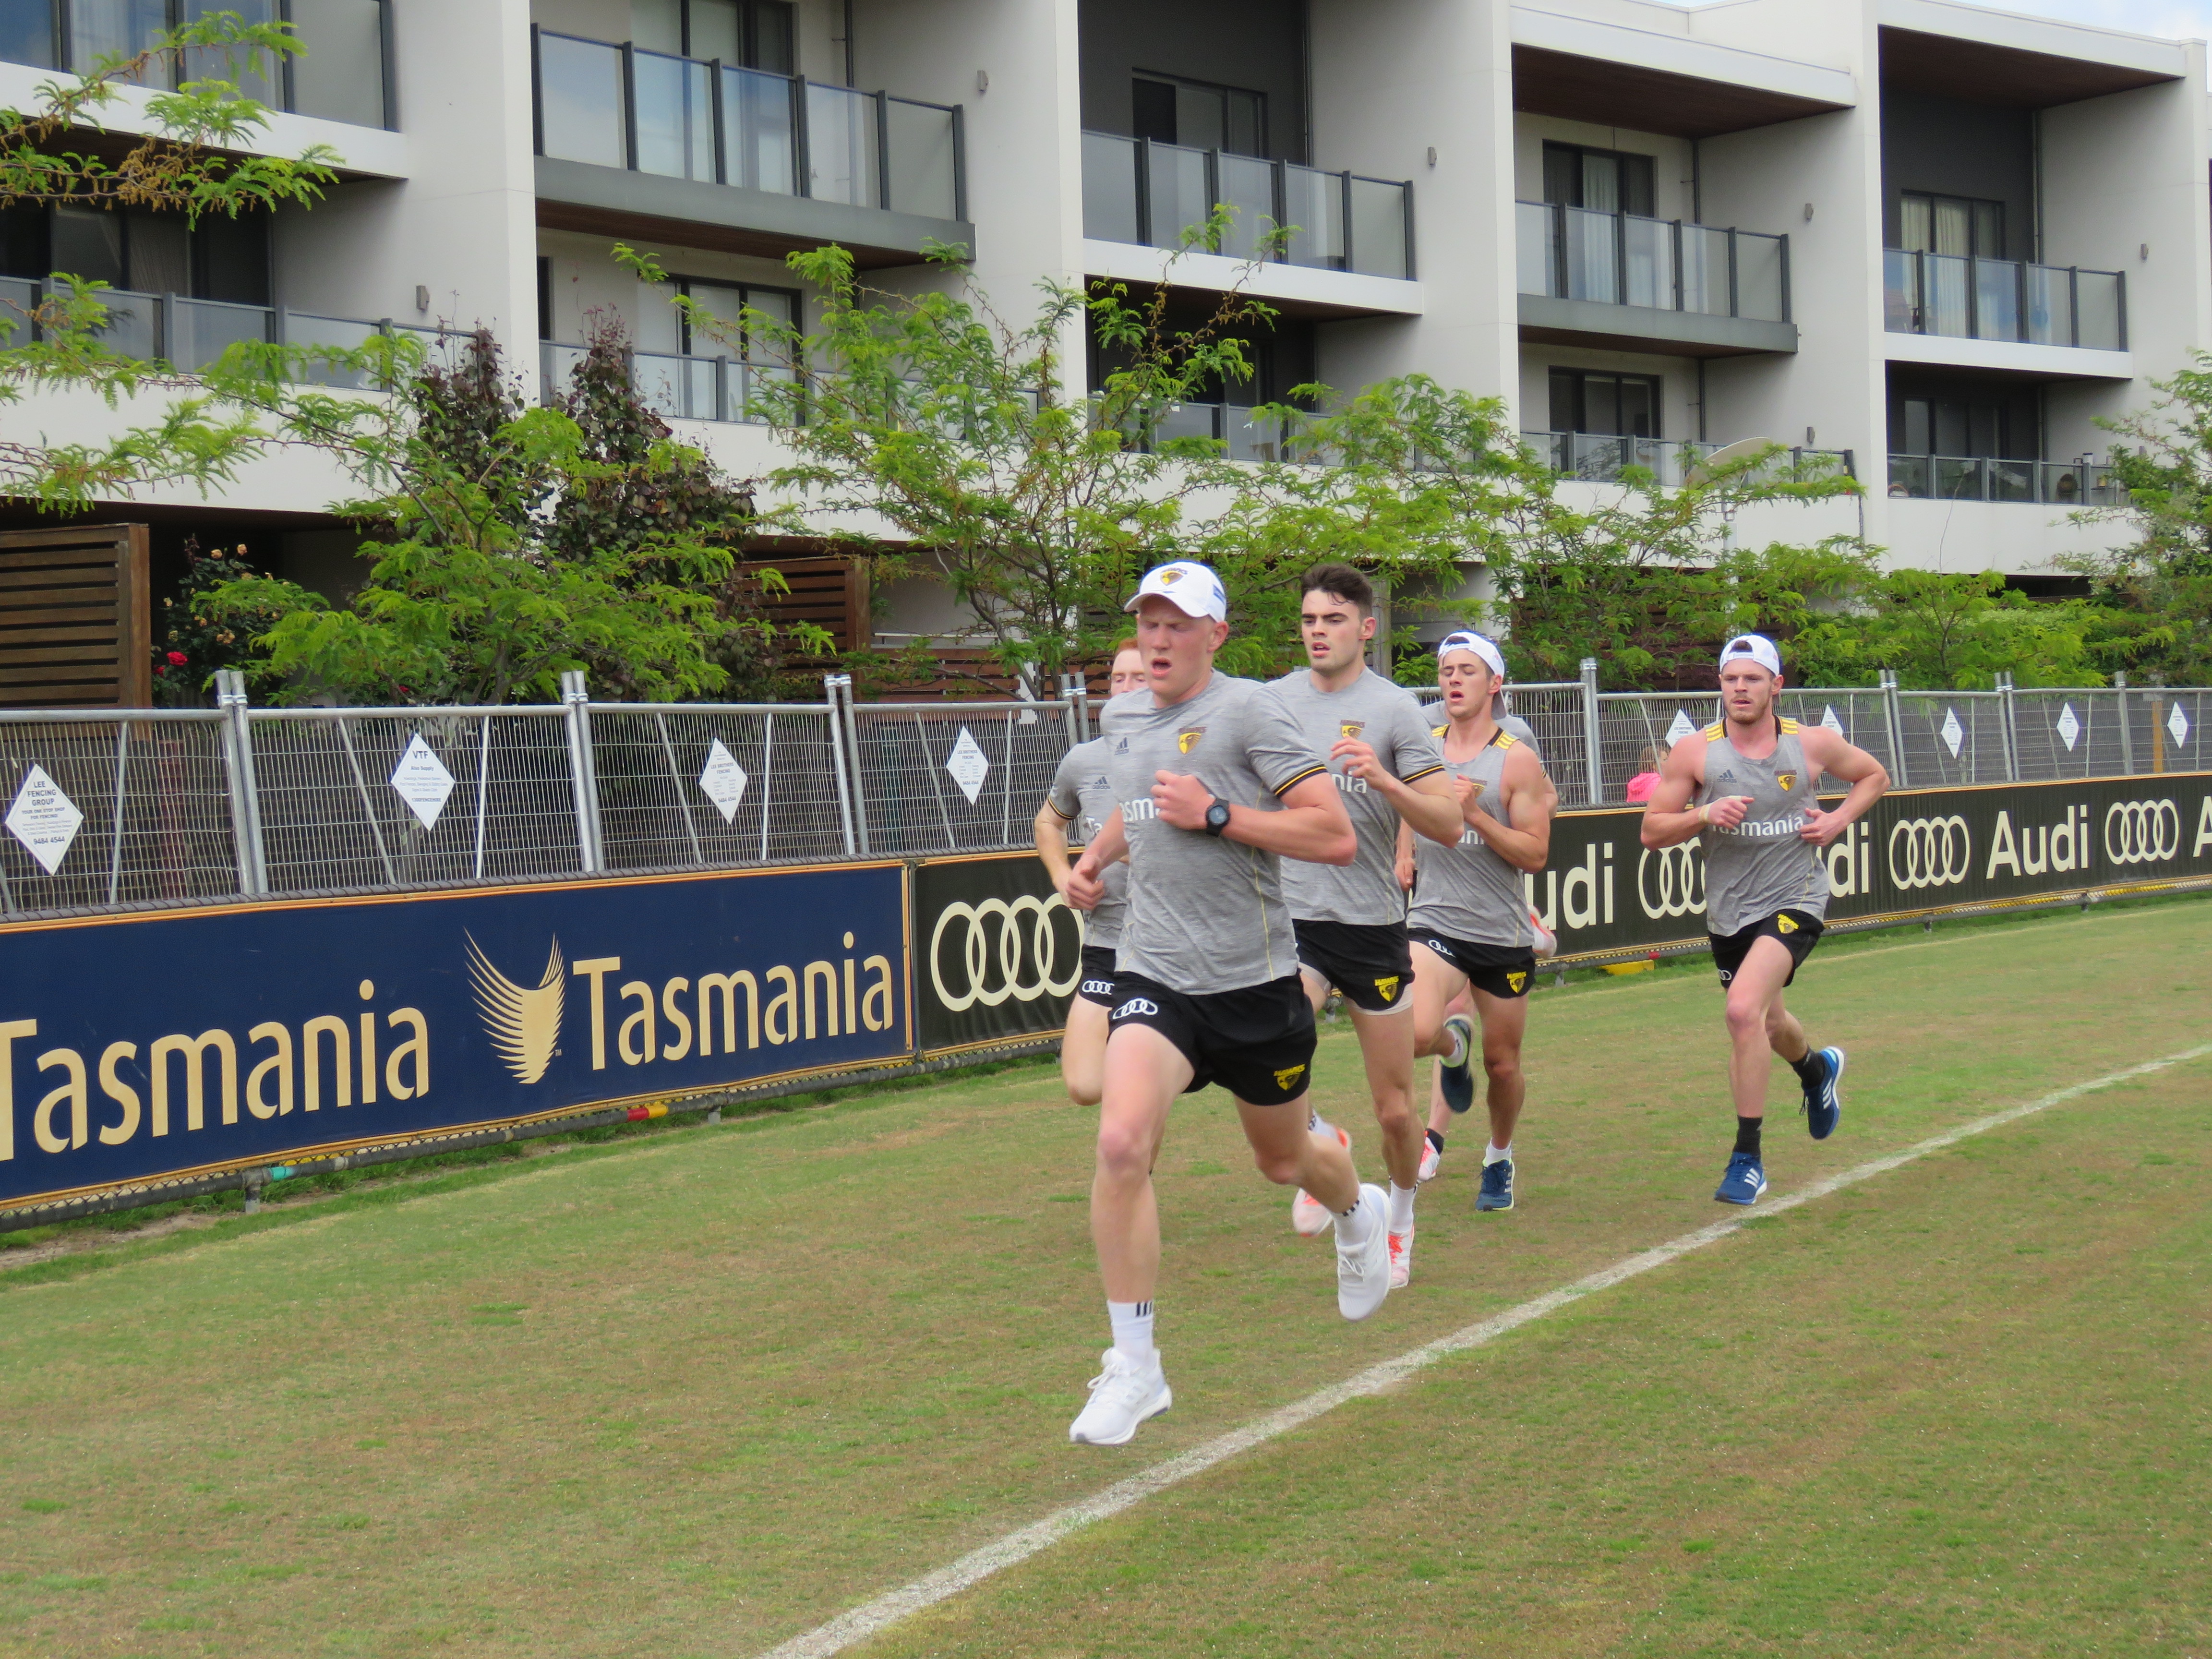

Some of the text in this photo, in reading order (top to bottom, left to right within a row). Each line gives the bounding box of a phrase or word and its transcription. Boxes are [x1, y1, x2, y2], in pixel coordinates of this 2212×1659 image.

[412, 750, 429, 759] VTF
[1524, 842, 1613, 931] udi
[1986, 804, 2088, 879] Audi
[0, 931, 893, 1161] Tasmania Tasmania
